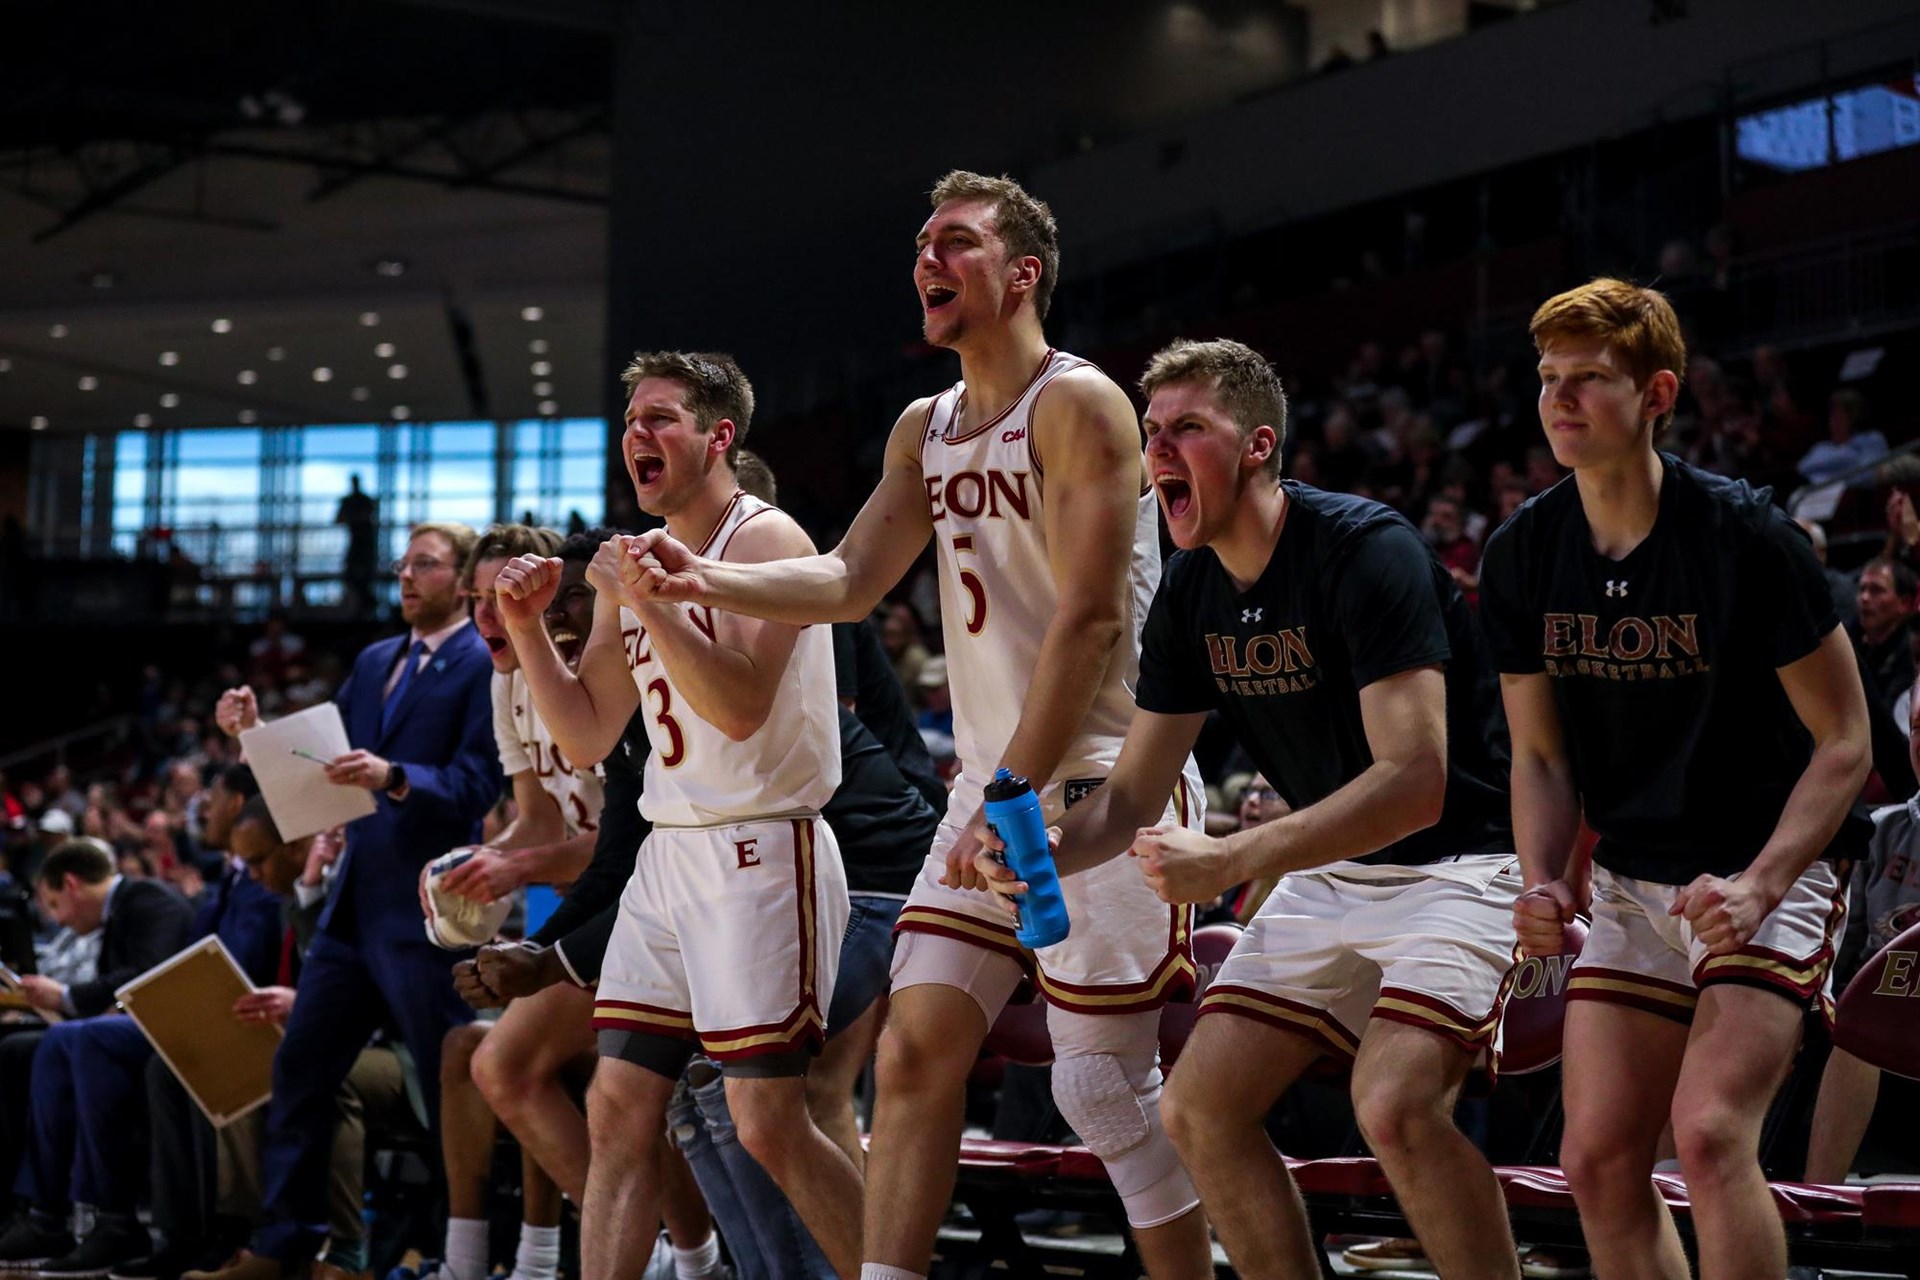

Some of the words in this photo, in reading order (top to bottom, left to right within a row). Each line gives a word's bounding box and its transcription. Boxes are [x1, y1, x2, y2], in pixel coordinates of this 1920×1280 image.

[924, 470, 1031, 523] EON
[621, 605, 719, 672] ELN
[1544, 613, 1699, 661] ELON
[1544, 656, 1712, 682] BASKETBALL
[647, 677, 688, 769] 3
[734, 838, 761, 869] E
[1511, 954, 1577, 1000] ON
